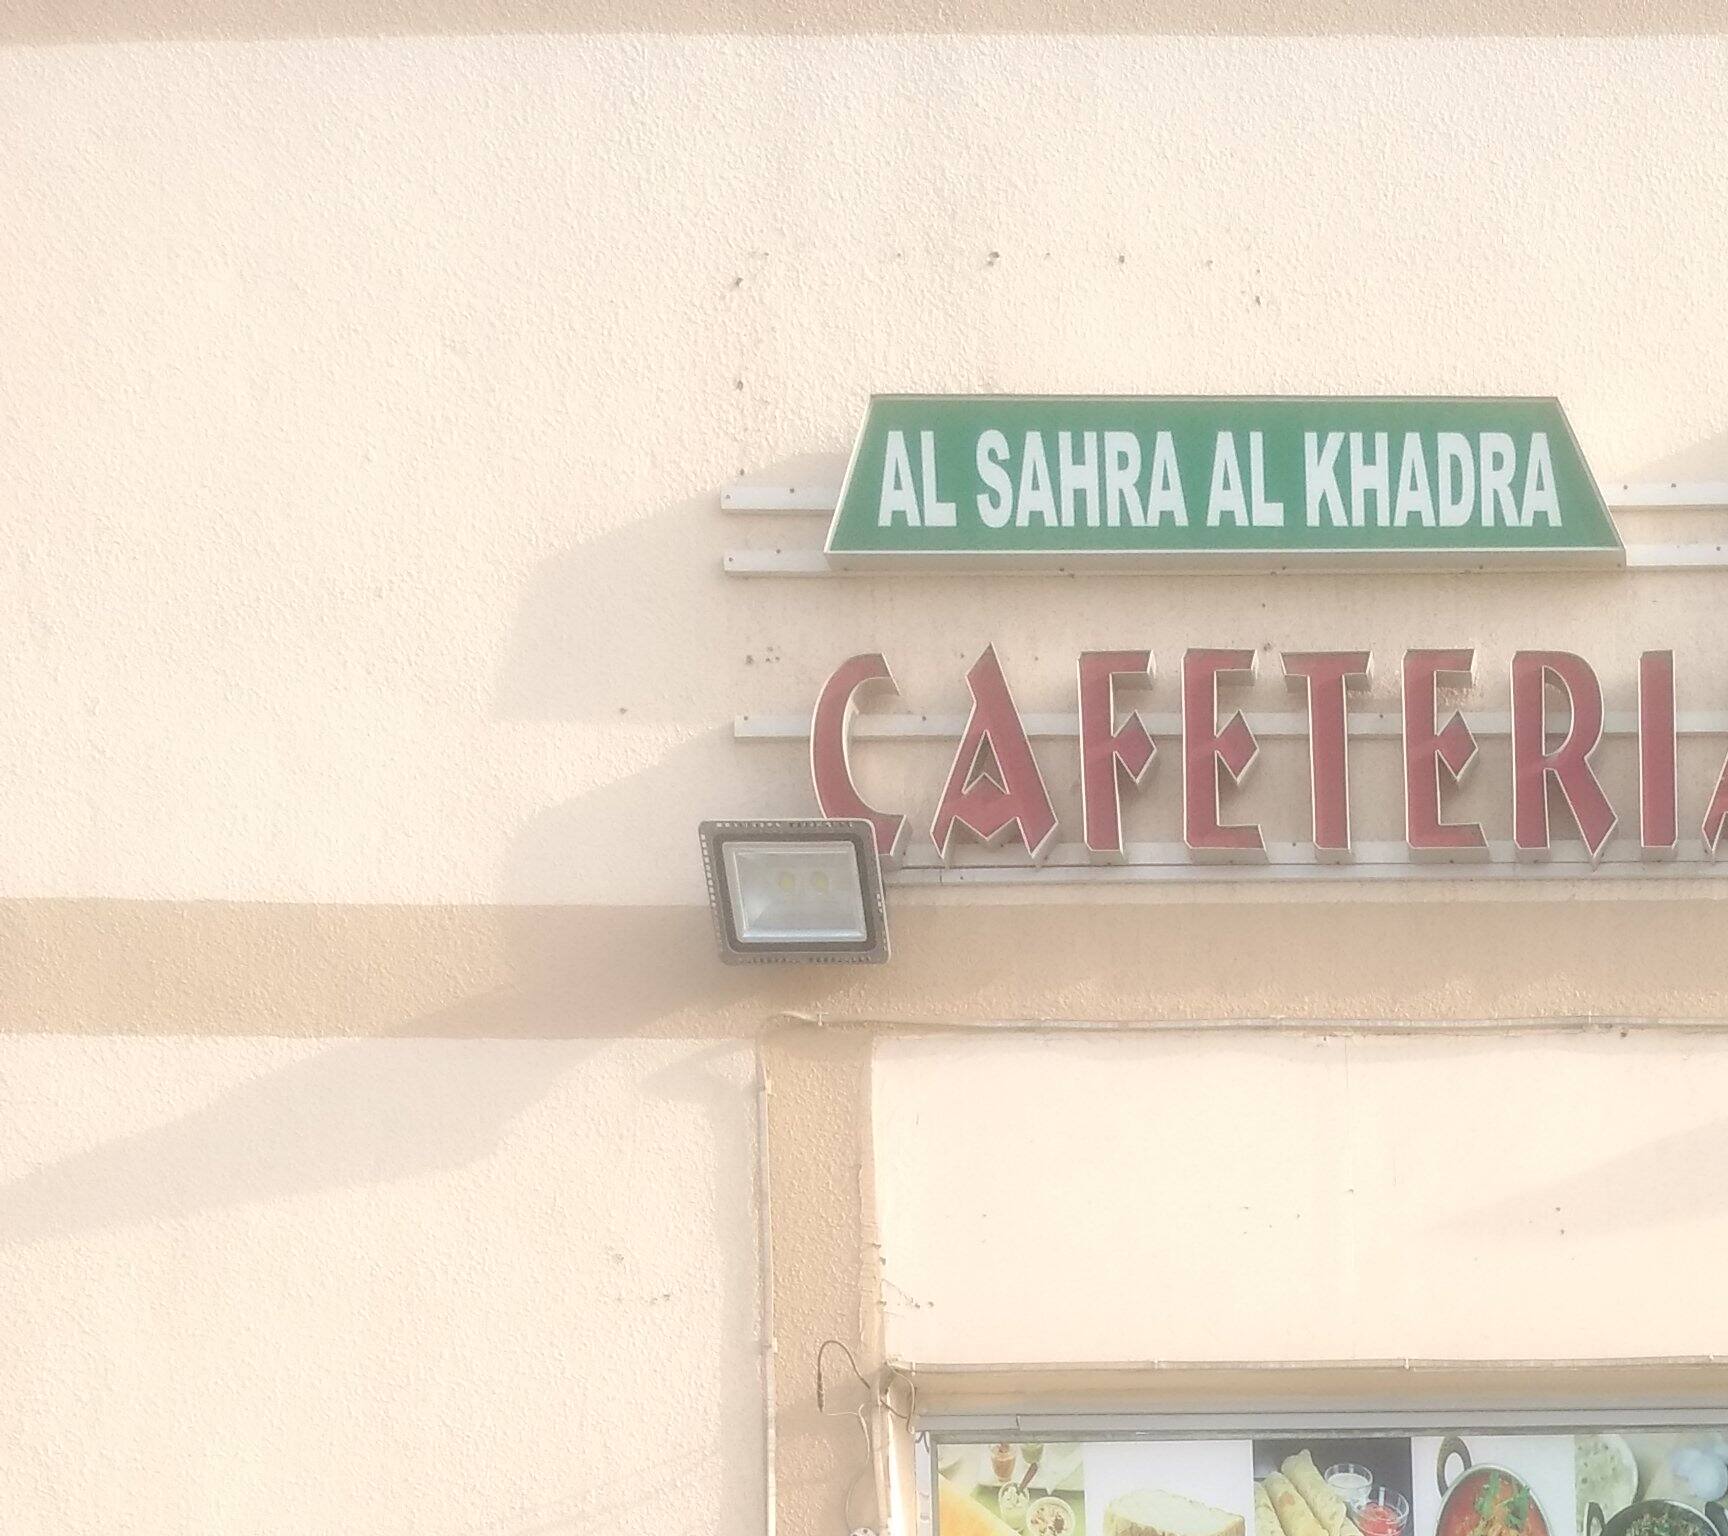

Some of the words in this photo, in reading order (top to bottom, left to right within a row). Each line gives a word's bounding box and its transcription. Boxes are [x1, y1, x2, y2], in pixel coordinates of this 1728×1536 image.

[877, 430, 957, 528] AL
[975, 429, 1189, 529] SAHRA
[1206, 430, 1285, 528] AL
[1306, 430, 1562, 528] KHADRA
